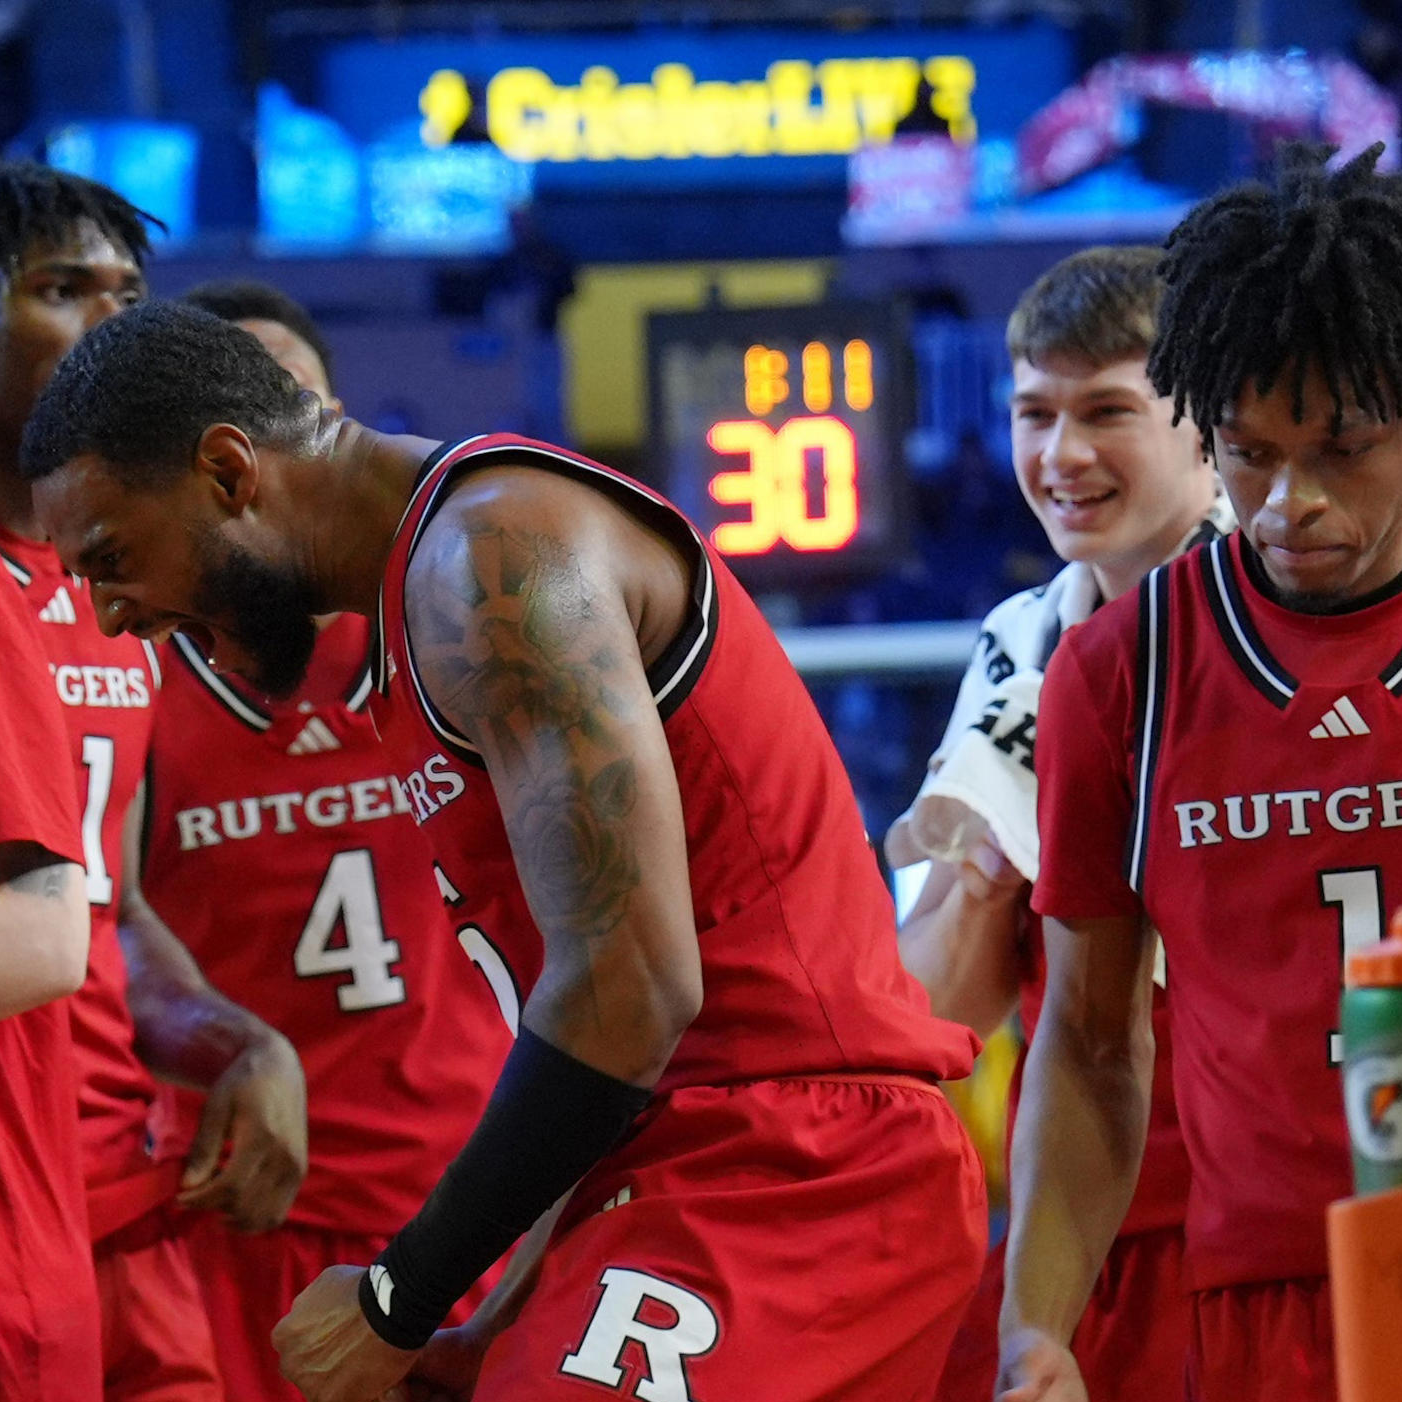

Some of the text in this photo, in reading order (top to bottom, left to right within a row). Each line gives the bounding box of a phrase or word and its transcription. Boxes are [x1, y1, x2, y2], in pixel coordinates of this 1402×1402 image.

[706, 416, 858, 556] 30
[48, 662, 150, 708] GERS
[294, 847, 407, 1013] 4
